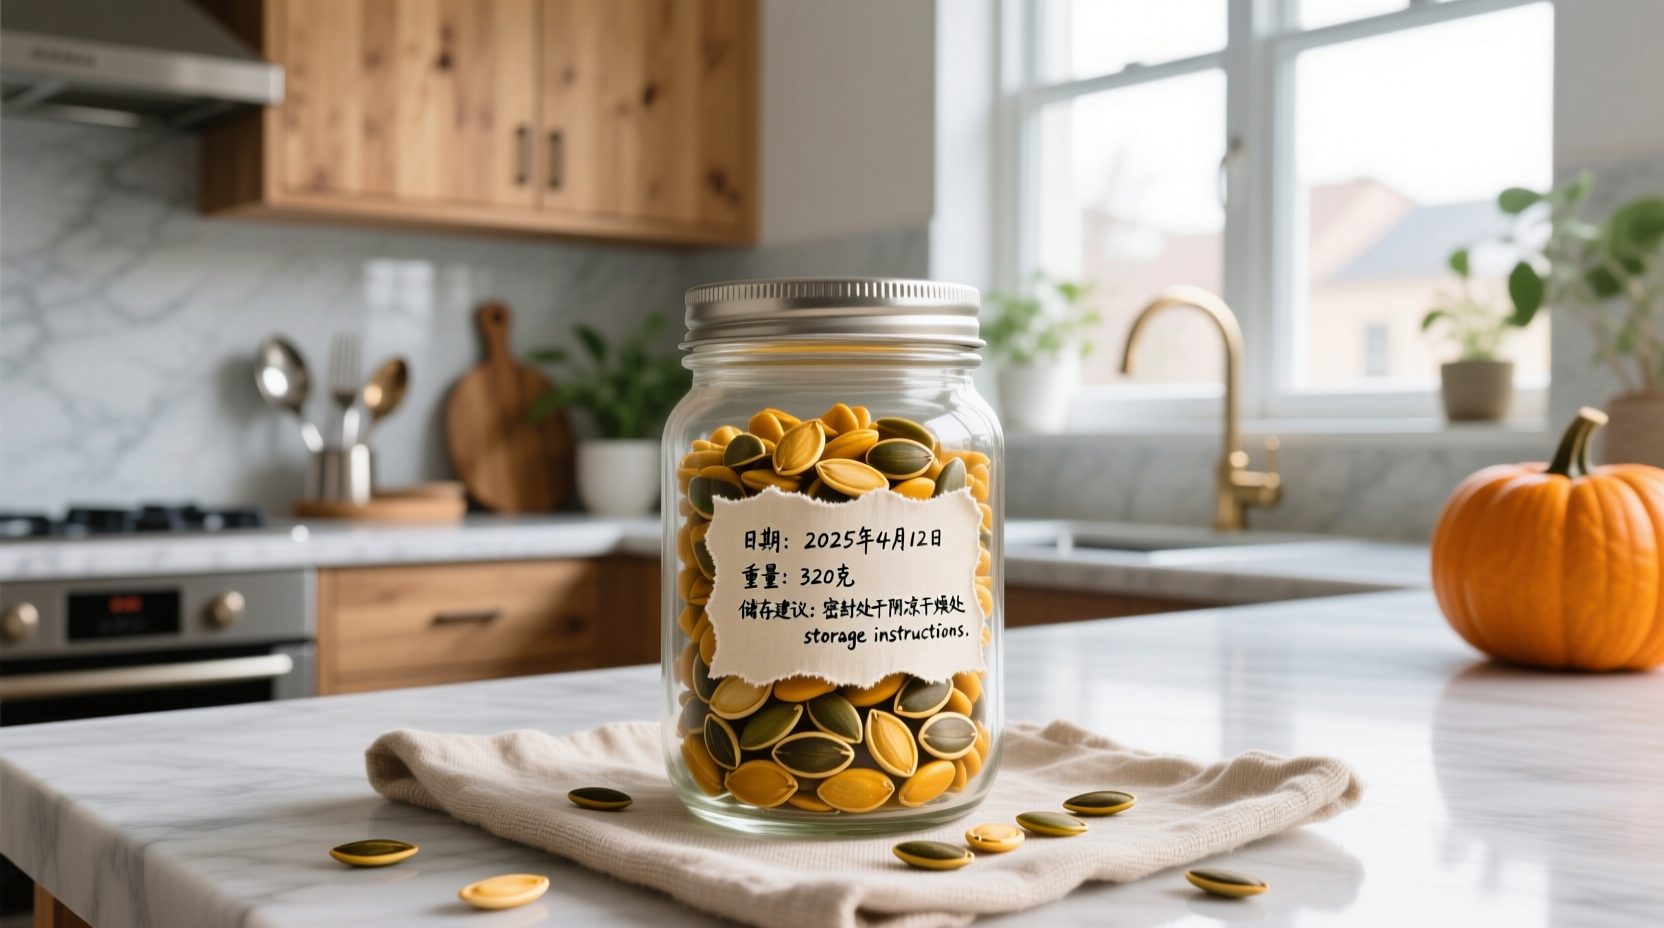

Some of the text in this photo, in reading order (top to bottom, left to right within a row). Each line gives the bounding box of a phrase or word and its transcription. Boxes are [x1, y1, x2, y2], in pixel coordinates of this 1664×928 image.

[744, 525, 942, 555] 日期： 2025年4月12日
[741, 562, 856, 590] 重量： 320克
[803, 622, 970, 651] storage instructions.
